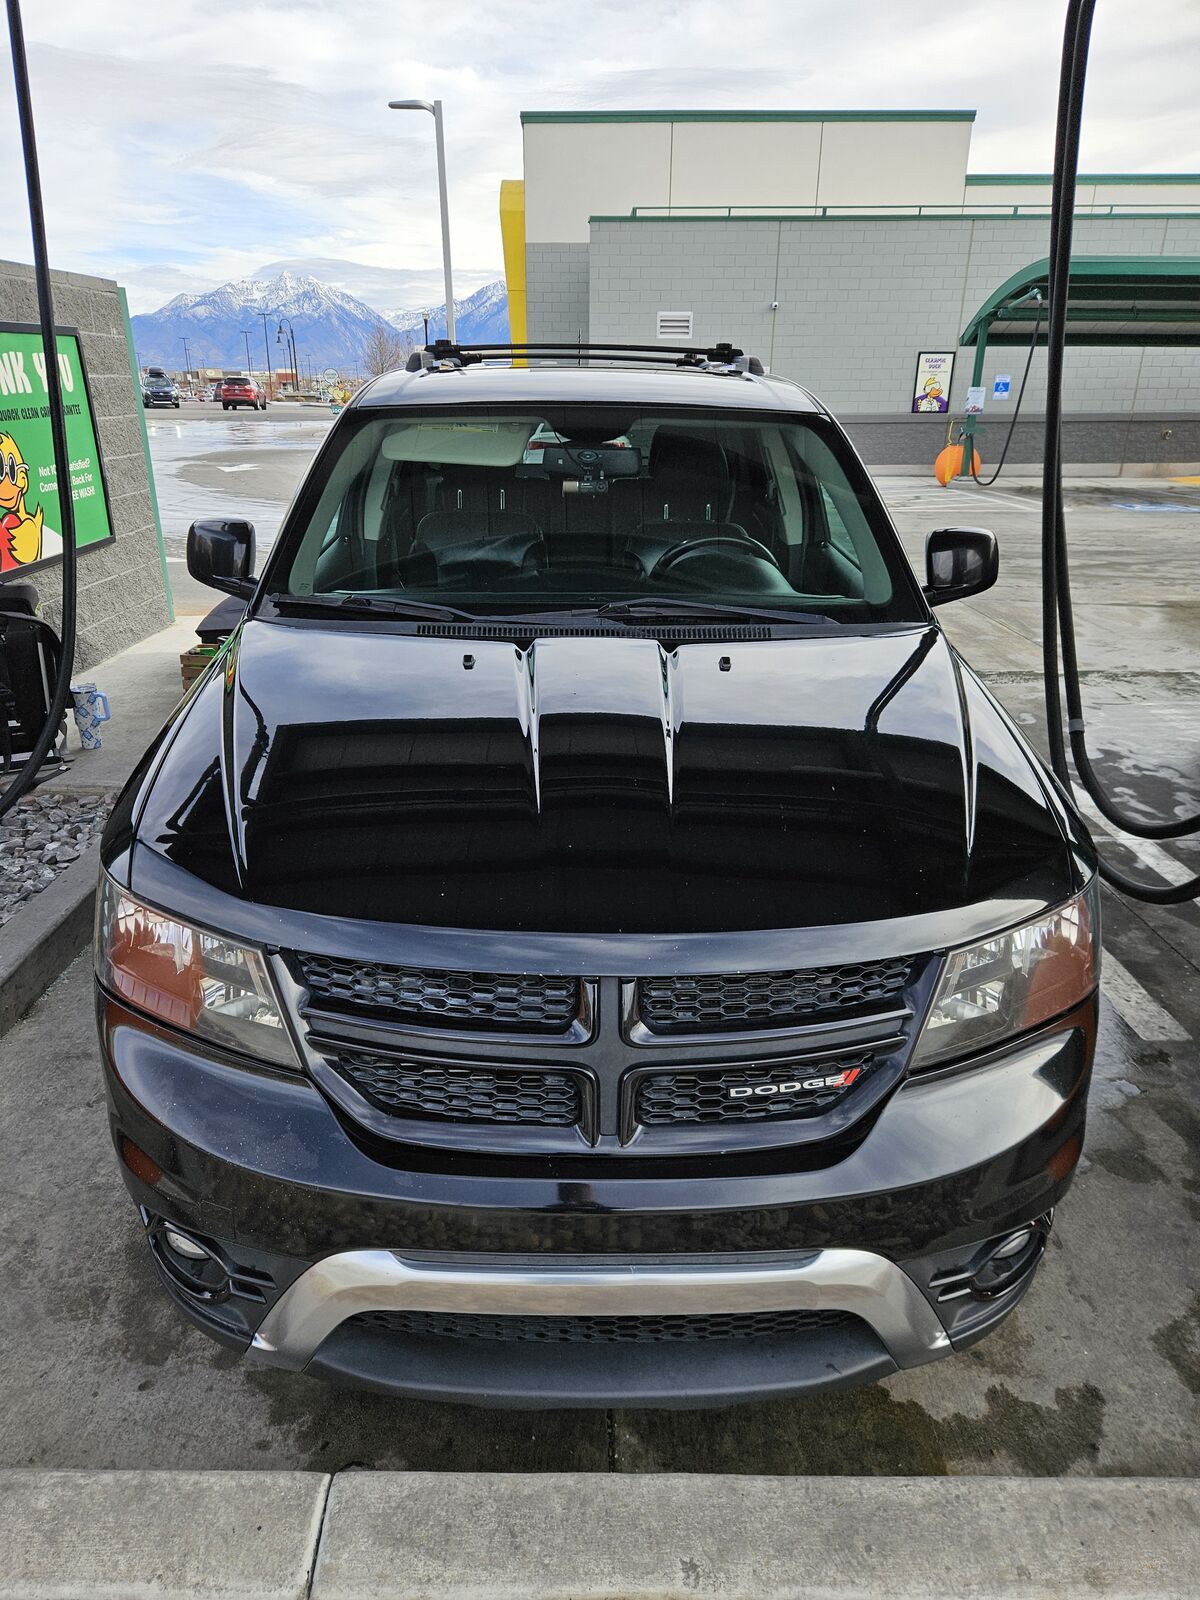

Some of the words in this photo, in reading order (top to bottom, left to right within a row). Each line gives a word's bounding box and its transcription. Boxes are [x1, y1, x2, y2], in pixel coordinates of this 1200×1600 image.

[32, 352, 74, 393] YU
[38, 466, 51, 477] Not
[69, 457, 90, 471] atisfied?
[71, 474, 85, 486] Back
[729, 1073, 846, 1098] DODGE
